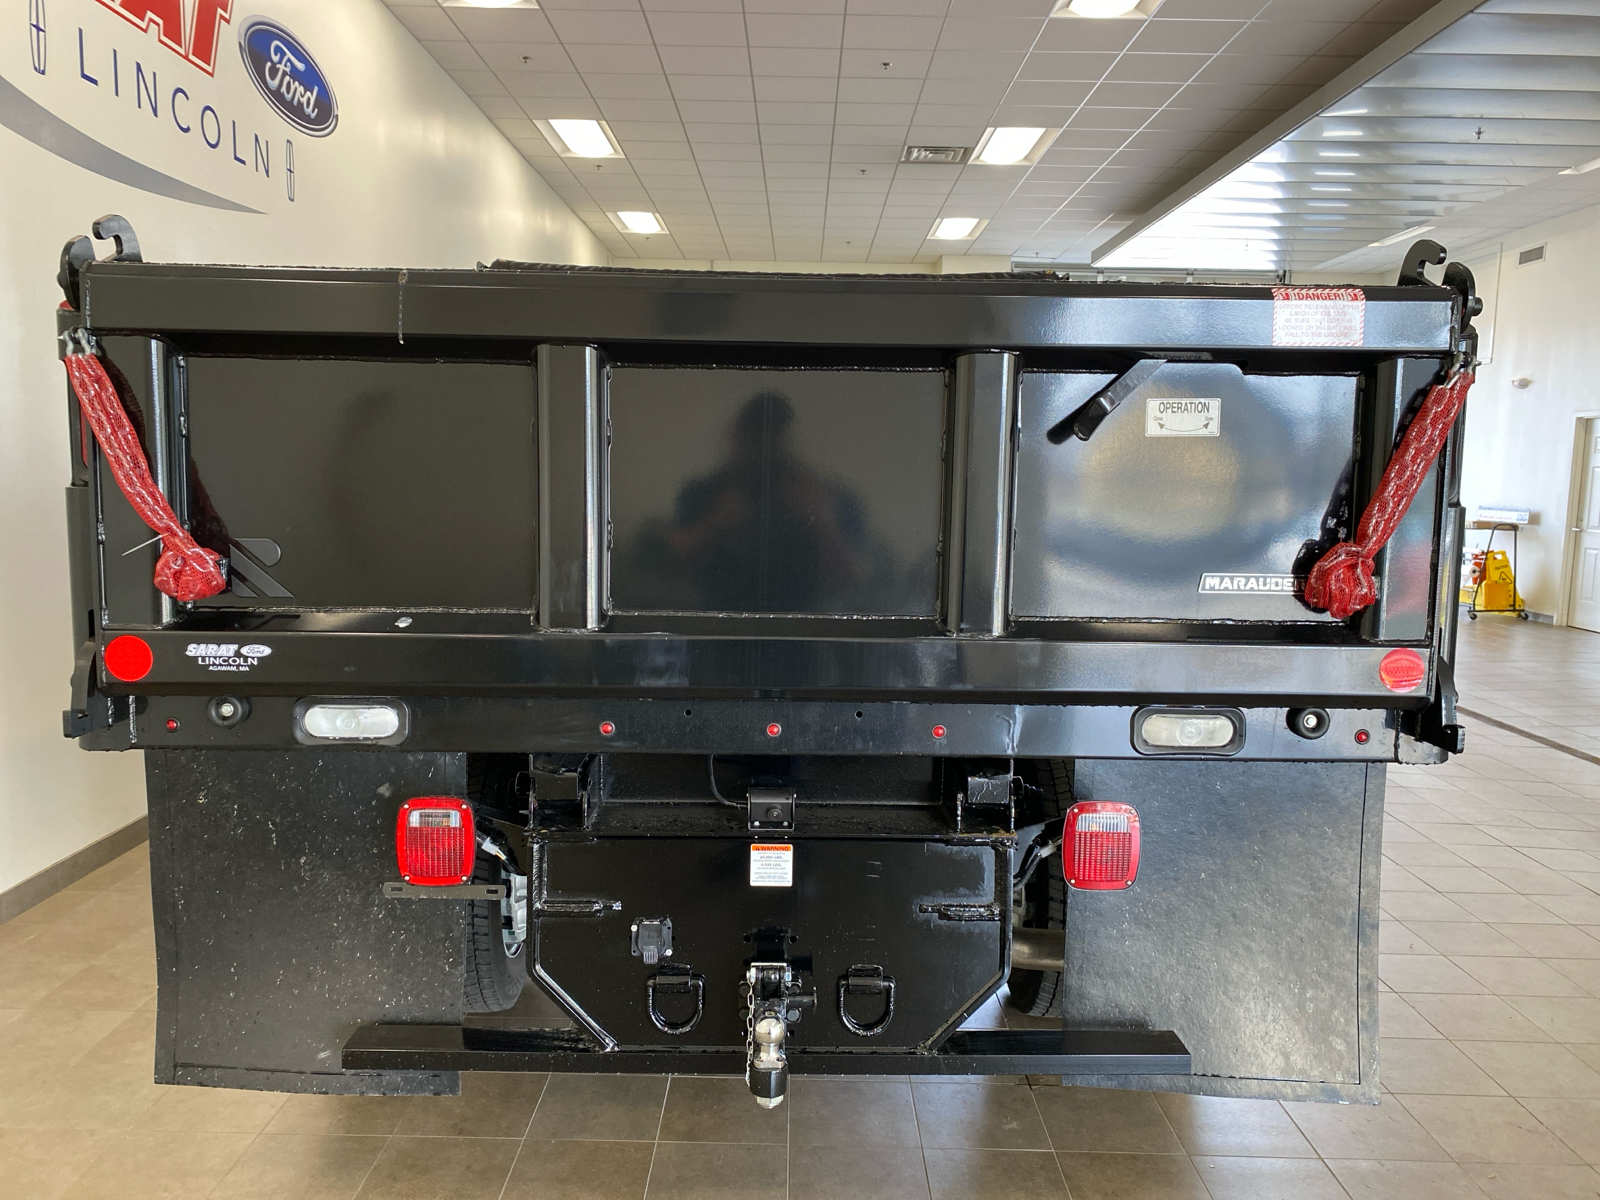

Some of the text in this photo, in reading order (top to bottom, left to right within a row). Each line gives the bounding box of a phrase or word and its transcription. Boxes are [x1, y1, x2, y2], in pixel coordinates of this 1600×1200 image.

[265, 40, 318, 119] Ford
[78, 27, 270, 178] LINCOLN
[1158, 401, 1210, 414] OPERATION
[185, 643, 238, 657] SARAT
[198, 657, 258, 665] LINCOLN
